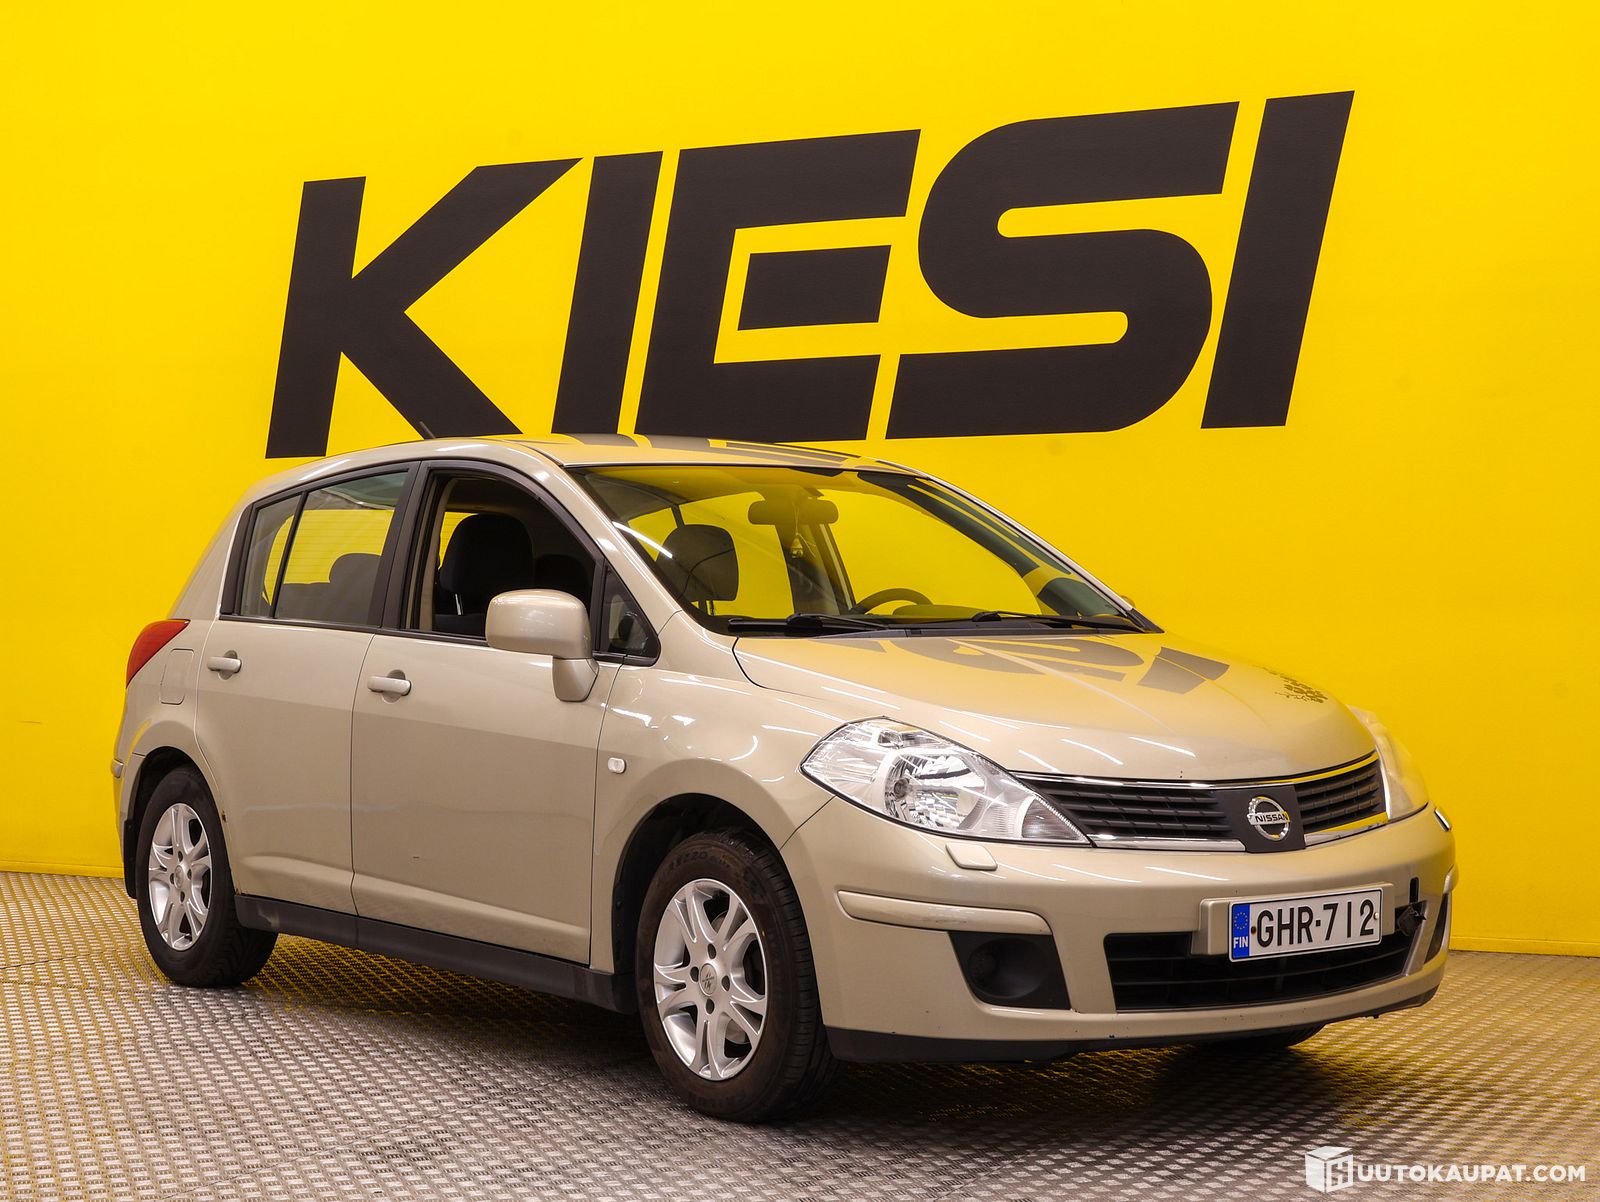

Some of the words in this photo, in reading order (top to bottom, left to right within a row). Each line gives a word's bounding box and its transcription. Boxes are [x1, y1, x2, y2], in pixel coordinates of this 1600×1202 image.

[265, 91, 1354, 458] KIESI
[1255, 812, 1289, 823] NISSAN
[1257, 899, 1374, 947] GHR-712
[1233, 936, 1249, 949] FIN
